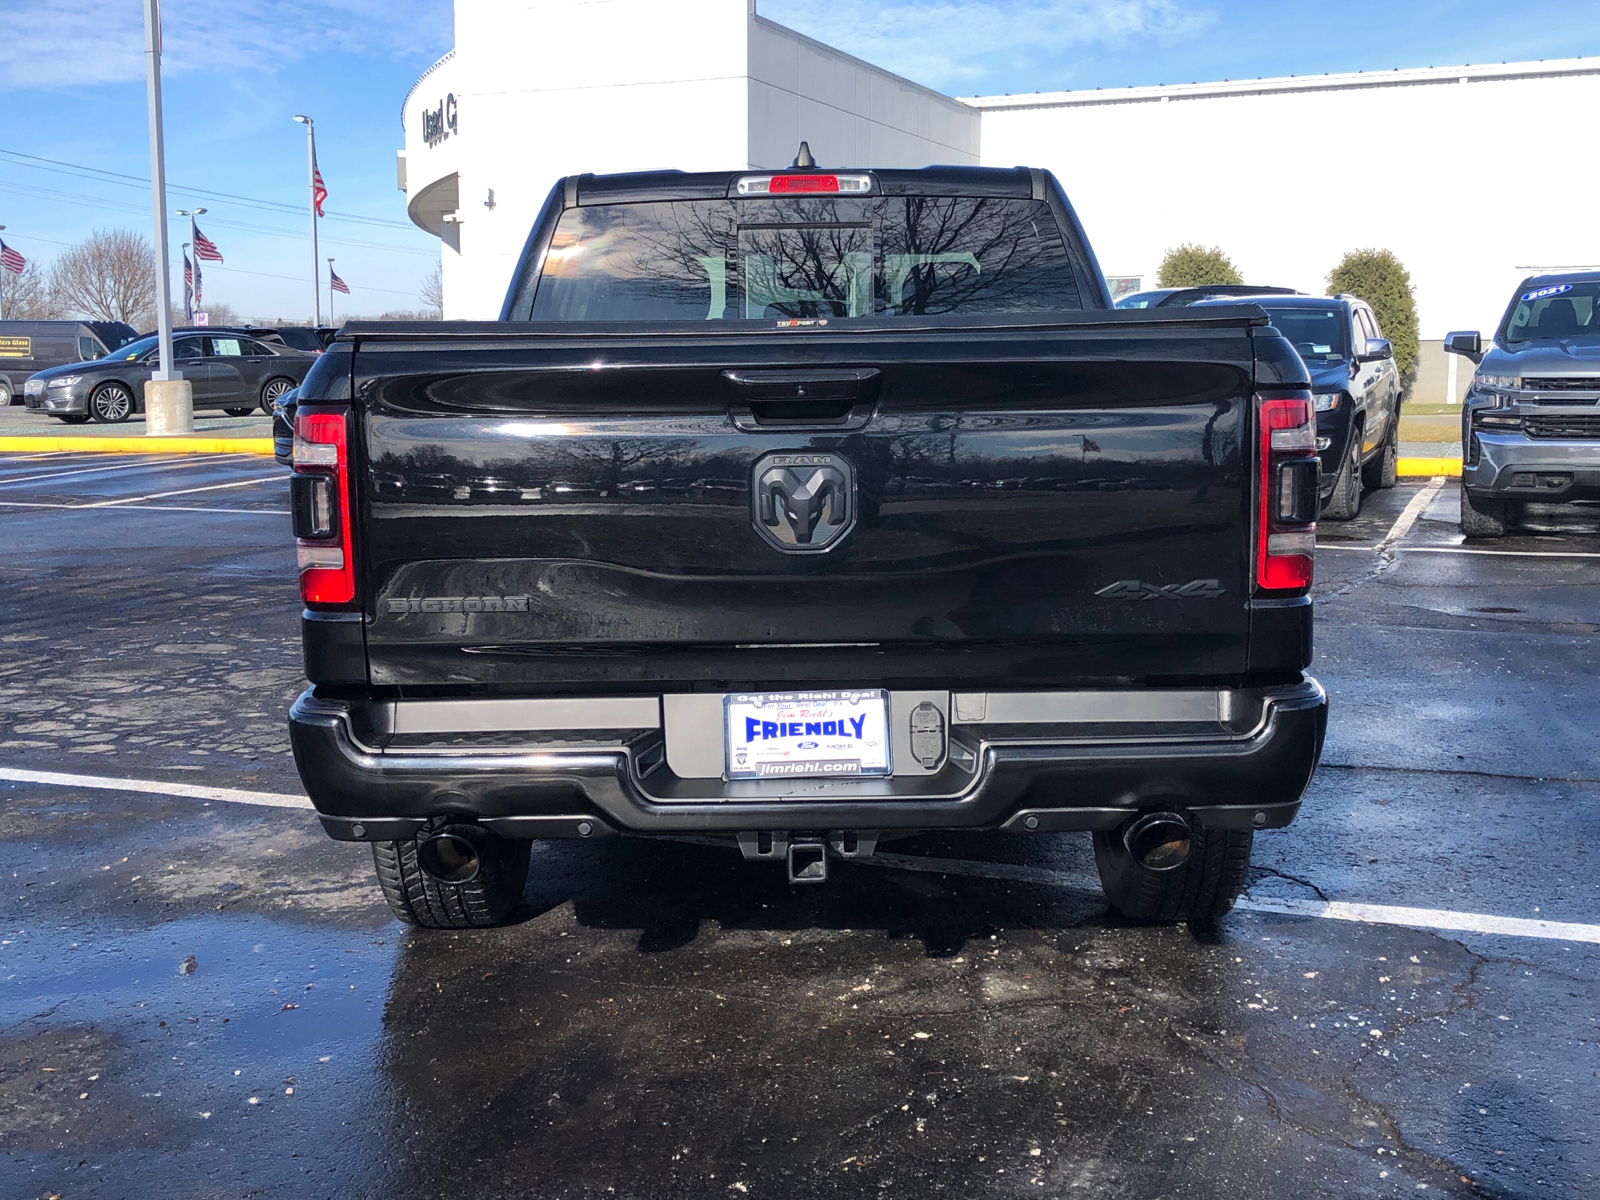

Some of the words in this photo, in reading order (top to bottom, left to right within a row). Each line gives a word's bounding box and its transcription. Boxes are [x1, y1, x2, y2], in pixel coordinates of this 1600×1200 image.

[422, 98, 444, 143] Used
[1528, 285, 1566, 300] 2021
[773, 455, 831, 464] RAM
[386, 596, 530, 613] BIGHORN
[769, 693, 793, 701] the
[797, 691, 836, 700] Riehl
[841, 691, 875, 699] Deal
[776, 711, 796, 721] Jim
[799, 709, 834, 718] Riehl's
[745, 713, 866, 743] FRIENDLY
[760, 763, 857, 775] jimriehl.com
